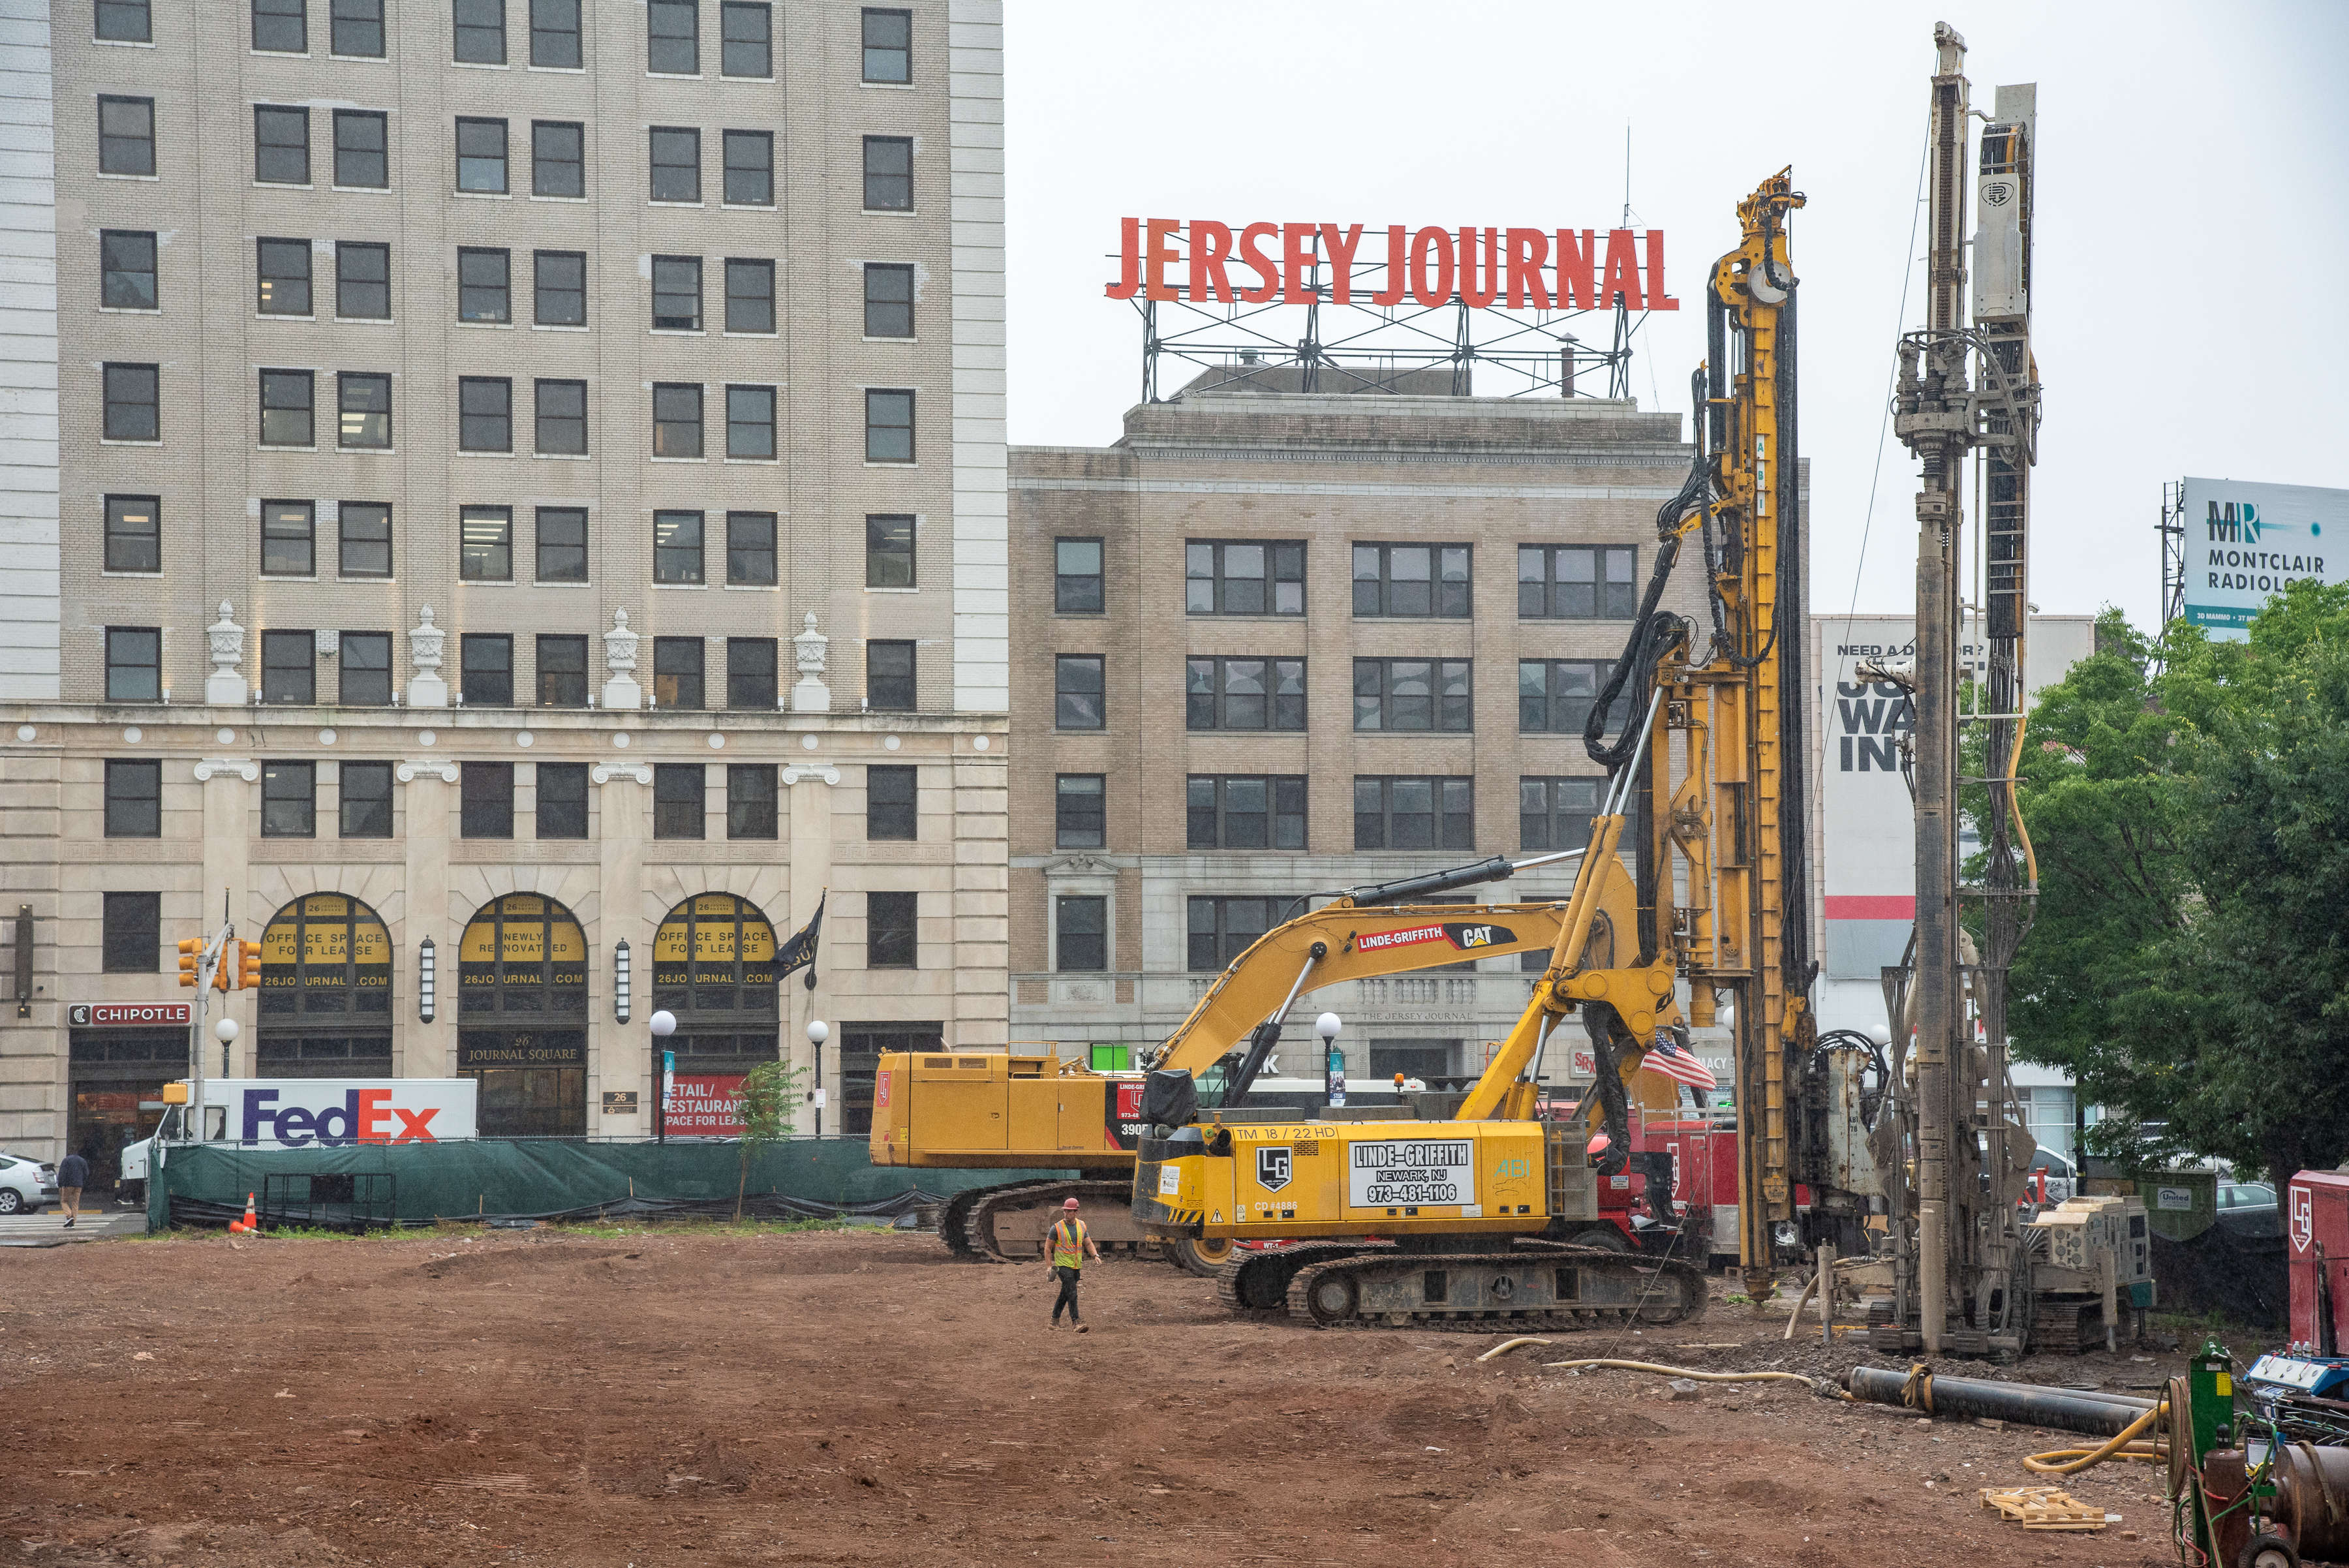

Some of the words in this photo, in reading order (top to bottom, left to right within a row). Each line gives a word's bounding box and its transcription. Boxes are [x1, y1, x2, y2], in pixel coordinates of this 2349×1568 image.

[1105, 217, 1364, 305] JERSEY
[1372, 225, 1680, 311] JOURNAL
[2209, 549, 2324, 574] MONTCLAIR
[2209, 572, 2324, 592] RADIOL
[1837, 645, 1882, 656] NEED
[1887, 645, 1897, 656] A
[266, 934, 322, 943] OFFICE
[330, 934, 382, 943] SPACE
[659, 932, 711, 941] OFFICE
[719, 932, 768, 941] SPACE
[1359, 926, 1443, 950] LINDE-GRIFFITH
[1462, 925, 1492, 947] CAT
[279, 946, 313, 955] FOR
[321, 946, 372, 955] LEASE
[671, 944, 703, 953] FOR
[711, 944, 758, 953] LEASE
[97, 1008, 186, 1021] CHIPOTLE
[515, 1036, 532, 1047] 26
[468, 1049, 525, 1062] JOURNAL
[529, 1049, 577, 1061] SQUARE
[1697, 1057, 1727, 1069] MACY
[614, 1092, 626, 1101] 26
[670, 1084, 715, 1098] ETAIL/
[664, 1099, 750, 1113] ESTAURAN
[242, 1088, 441, 1146] FedEx
[664, 1116, 693, 1126] PACE
[696, 1116, 716, 1126] FOR
[719, 1116, 750, 1126] LEAS
[1237, 1129, 1258, 1139] TM
[1264, 1129, 1277, 1139] 18
[1283, 1128, 1288, 1139] /
[1294, 1128, 1312, 1139] 22
[1315, 1128, 1335, 1137] HD
[1355, 1143, 1468, 1168] LINDE-GRIFFITH
[1263, 1148, 1288, 1178] LG
[1494, 1159, 1530, 1177] ABI
[1376, 1169, 1429, 1182] NEWARK,
[1431, 1169, 1447, 1181] NJ
[1368, 1184, 1457, 1203] 973-481-1106
[1255, 1201, 1268, 1211] CD
[1270, 1201, 1298, 1210] #4886
